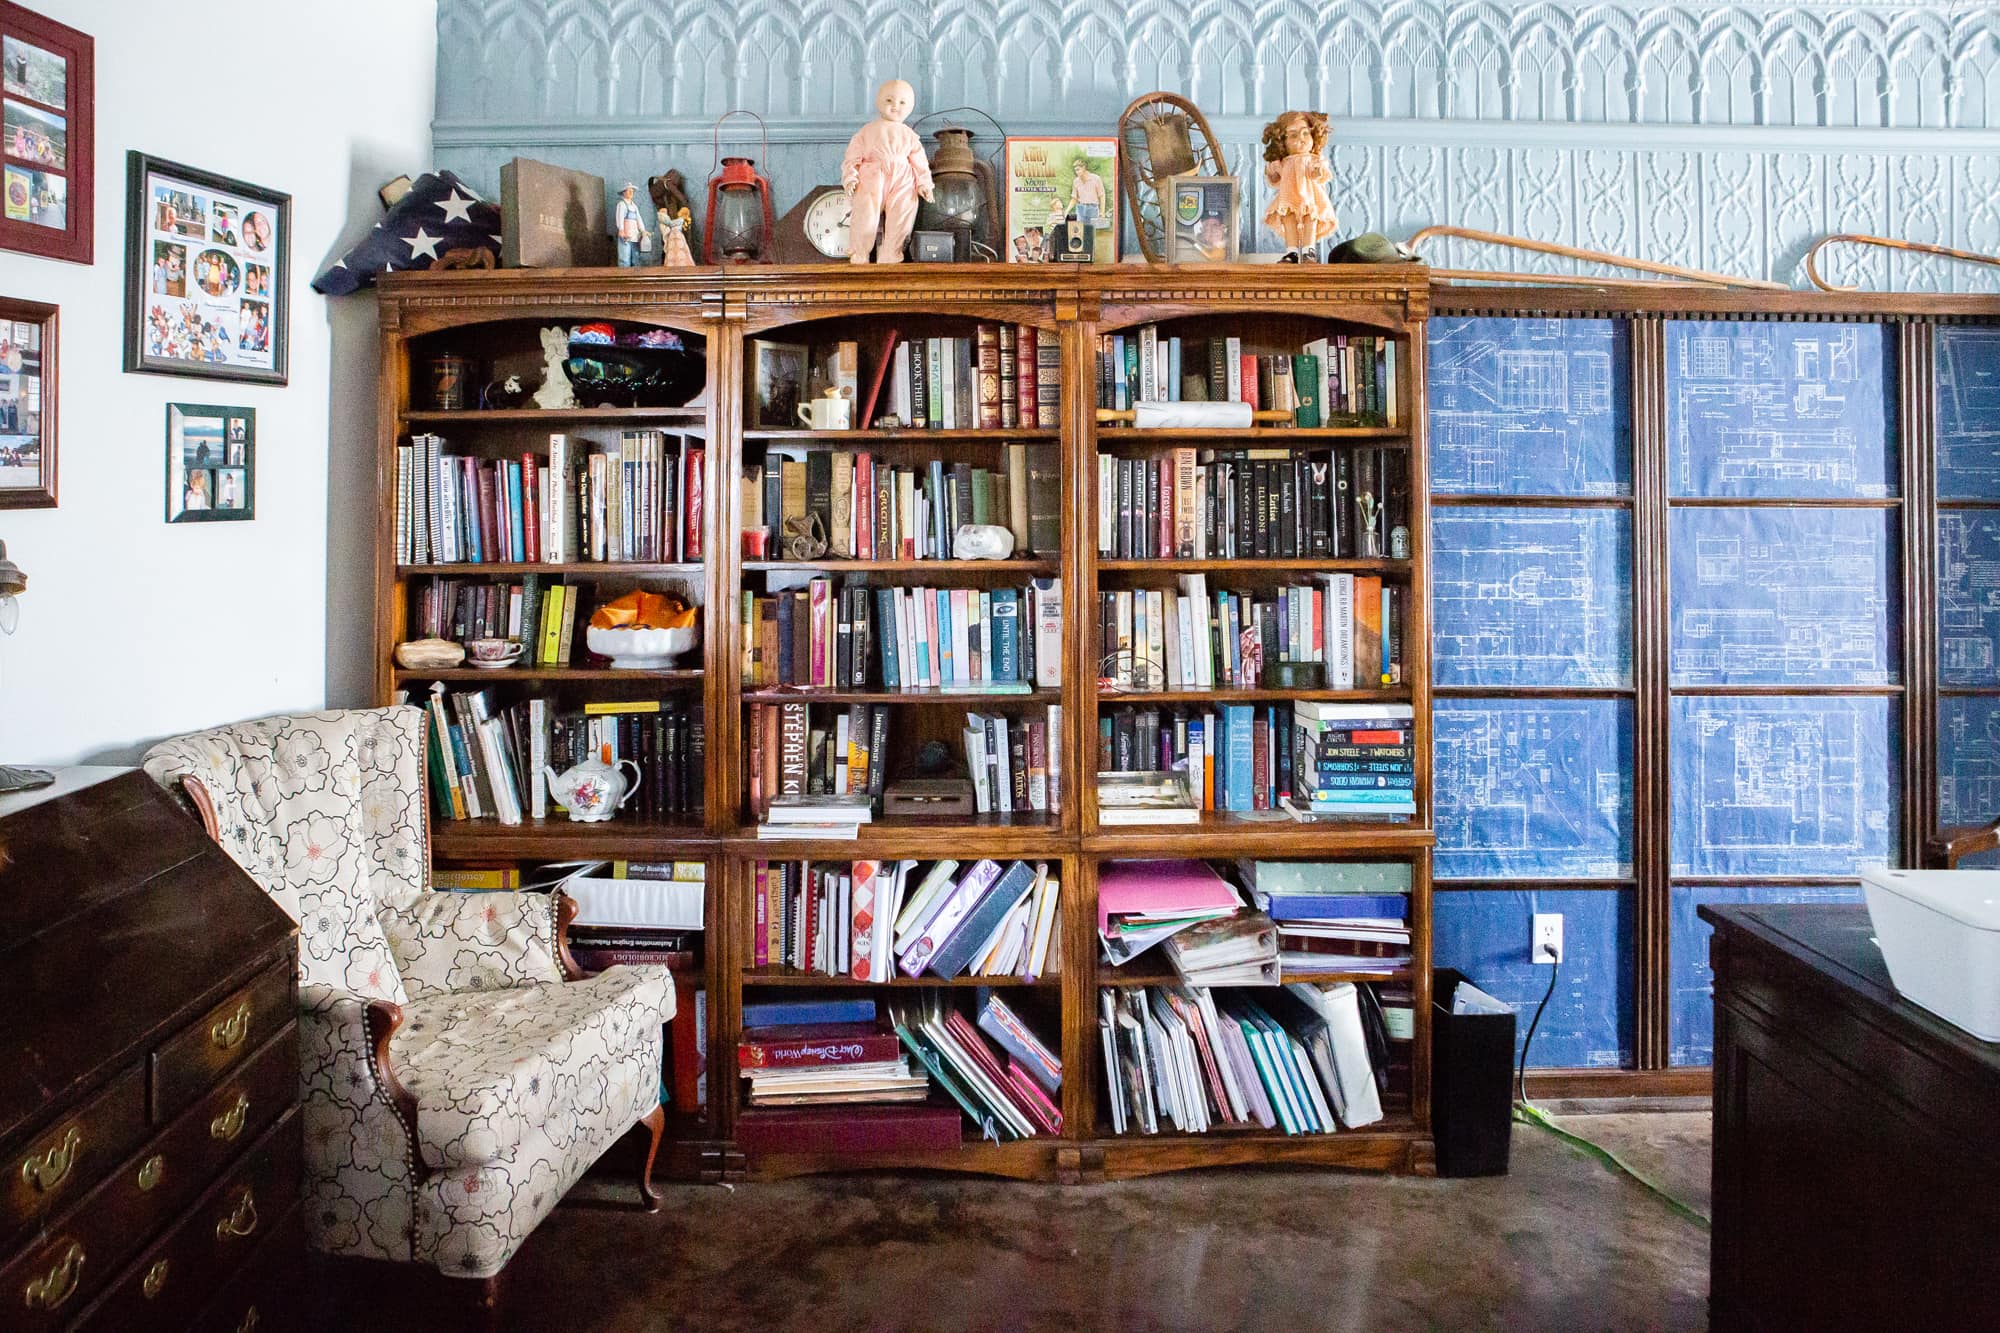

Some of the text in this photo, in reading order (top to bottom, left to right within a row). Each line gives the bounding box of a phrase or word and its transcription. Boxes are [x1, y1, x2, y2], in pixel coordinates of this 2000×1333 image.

[914, 353, 923, 409] BOOK THIEF
[1144, 339, 1153, 402] Clockwork Ange
[1180, 452, 1193, 490] DAN BROWN
[580, 484, 588, 495] Dog
[1163, 486, 1172, 520] forever
[879, 489, 889, 544] GRACELING
[1258, 486, 1266, 533] ILLUSIONS
[1269, 493, 1279, 522] Entice
[1340, 606, 1348, 628] MARTIN
[1002, 619, 1010, 672] UNTIL THE END
[784, 703, 799, 794] STEPHEN KI
[873, 713, 884, 763] IMPRESSIONIST
[1325, 748, 1405, 757] JON STEELE WATCHERS
[1323, 763, 1403, 771] JON STEELE SORROWS
[1015, 770, 1025, 798] TALTOS
[1330, 777, 1348, 786] GODS
[576, 938, 611, 946] Rebuilding
[612, 938, 634, 947] Engine
[774, 1049, 802, 1059] World
[800, 1044, 842, 1060] Disney
